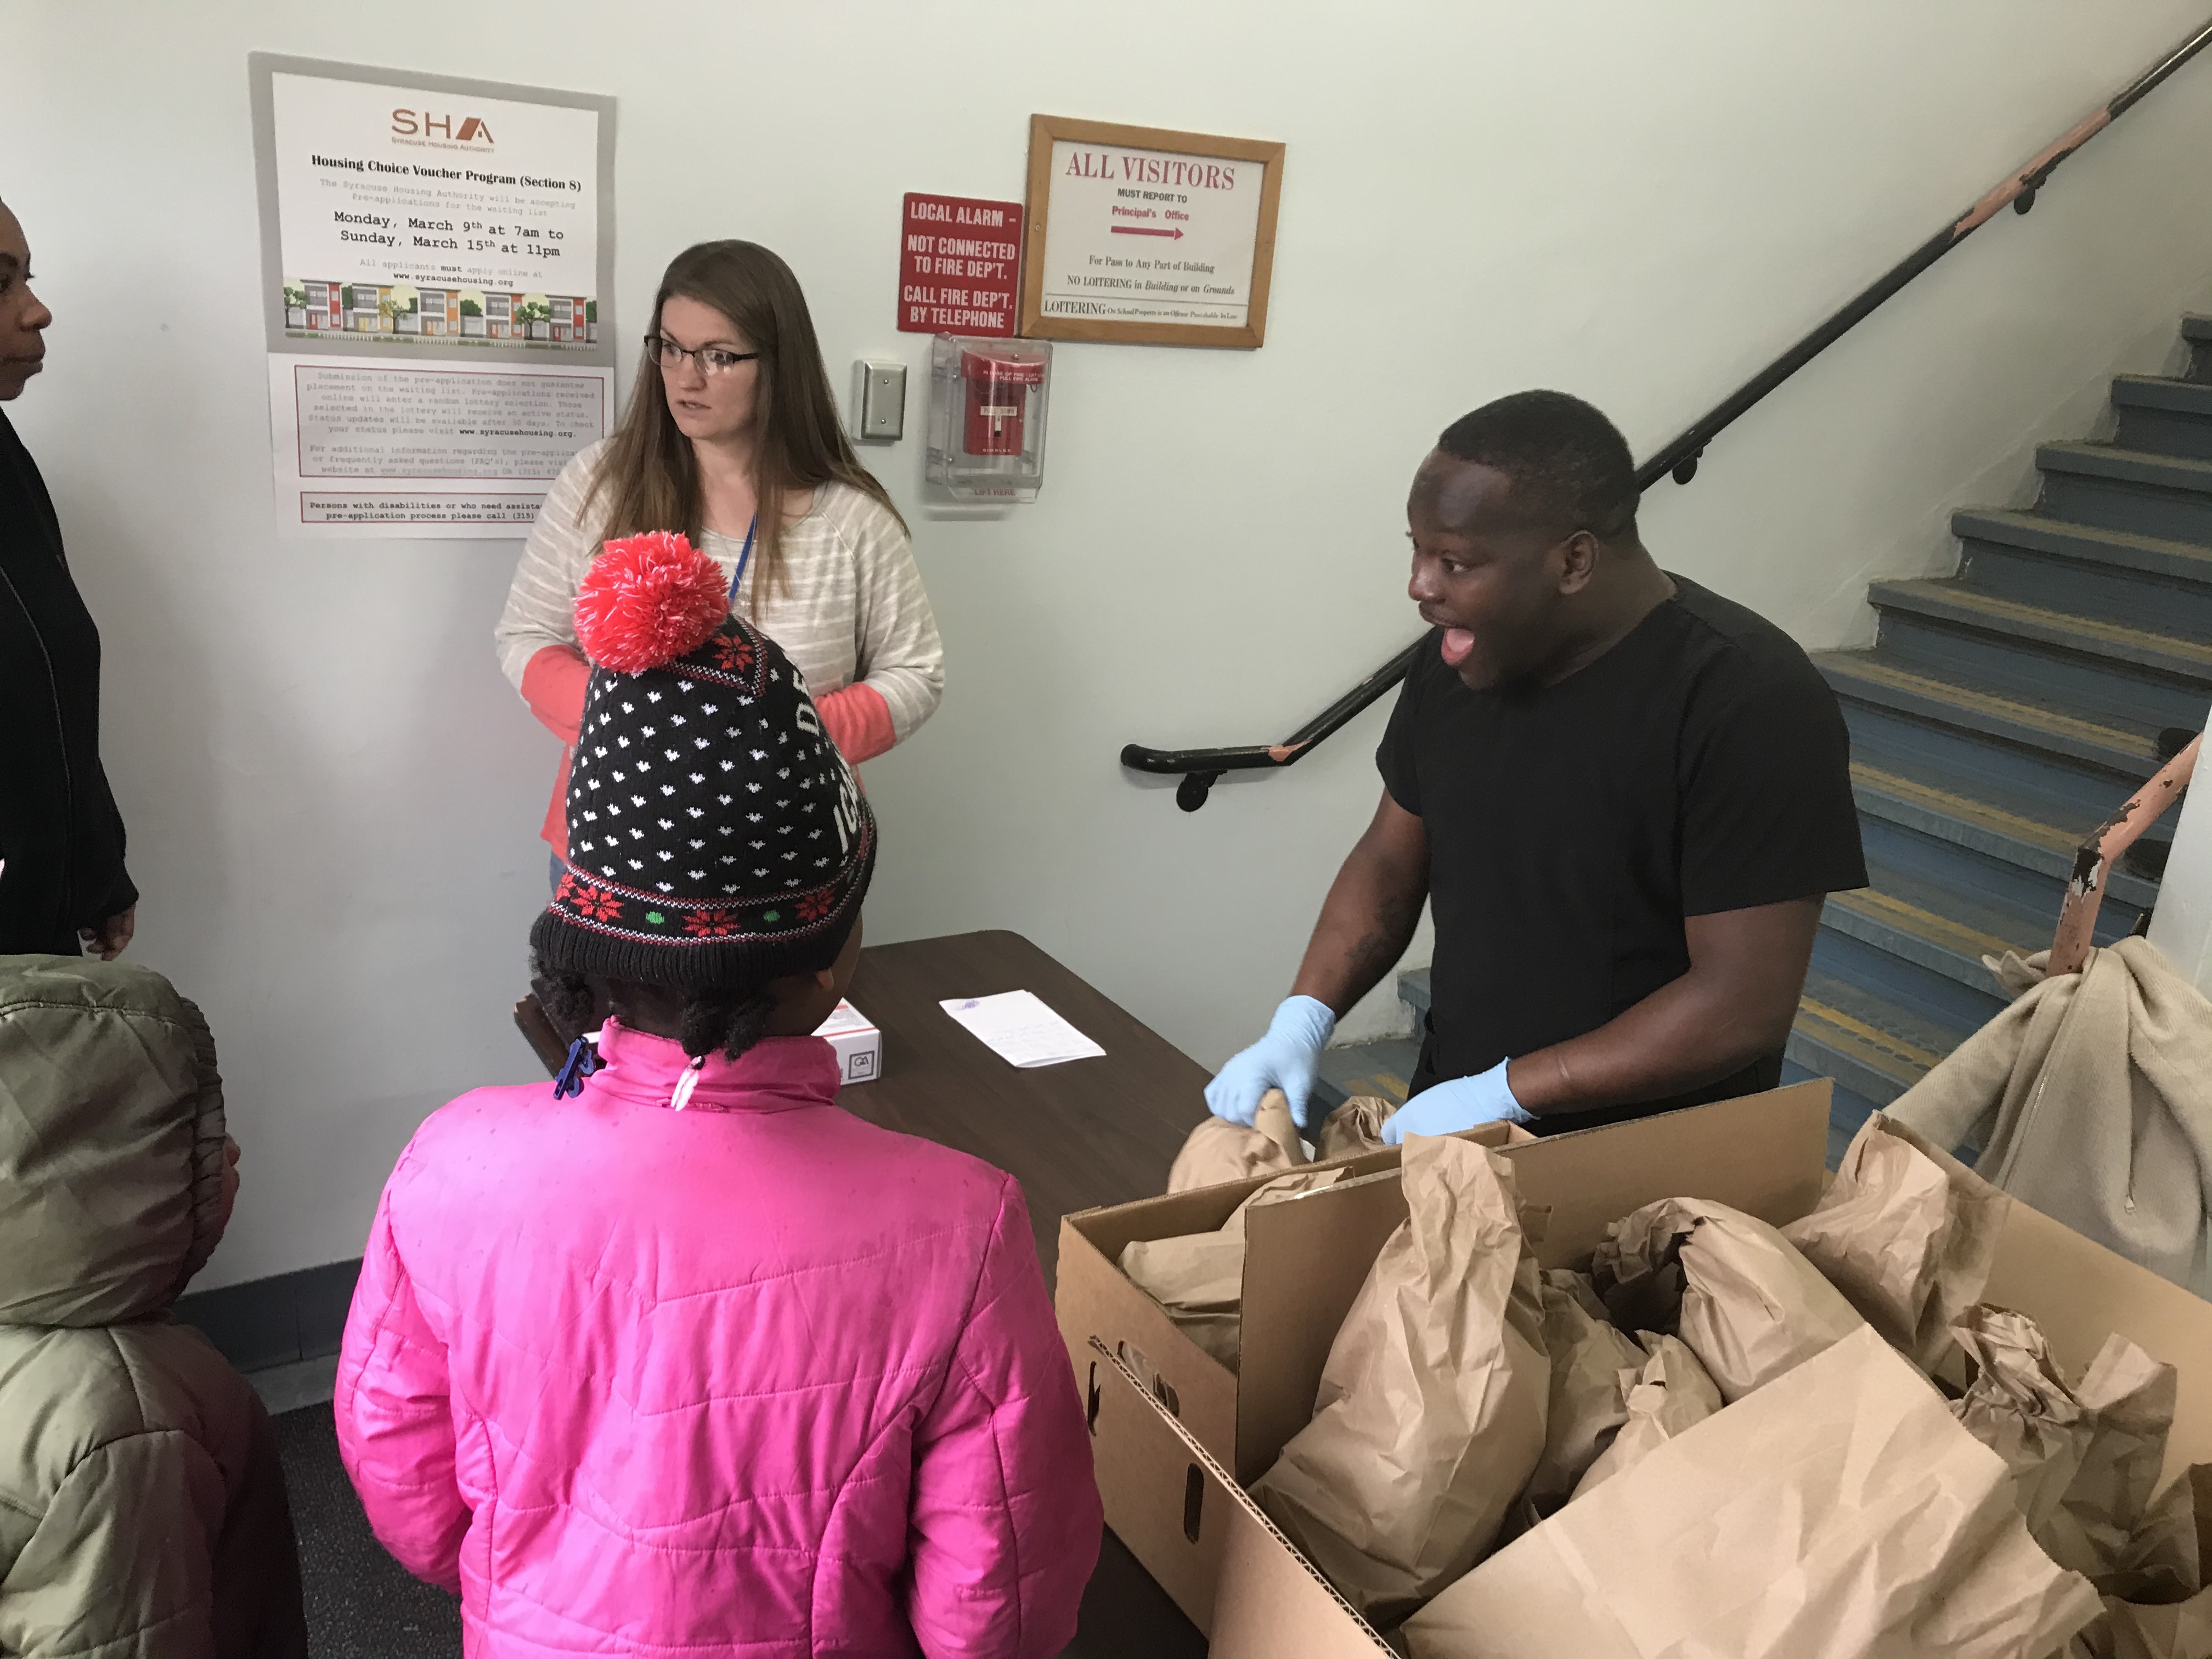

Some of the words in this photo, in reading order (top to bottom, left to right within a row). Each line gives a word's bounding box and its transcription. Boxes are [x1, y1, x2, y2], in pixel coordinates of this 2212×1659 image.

[391, 108, 494, 144] SHA
[312, 155, 364, 172] Housing
[368, 160, 409, 174] Choice
[413, 165, 461, 179] Voucher
[466, 170, 516, 185] Program
[520, 175, 565, 189] (Section
[569, 179, 581, 192] 8)
[1065, 151, 1115, 179] ALL
[1122, 156, 1234, 190] VISITORS
[320, 179, 337, 187] The
[343, 181, 387, 192] Syracuse
[393, 185, 431, 196] Housing
[437, 190, 484, 201] Authority
[489, 195, 509, 203] will
[530, 198, 575, 210] accepting
[352, 193, 439, 207] Pre-applications
[466, 203, 482, 211] the
[487, 205, 522, 215] waiting
[1118, 188, 1141, 198] MUST
[1143, 190, 1175, 202] REPORT
[1177, 194, 1187, 203] TO
[910, 201, 952, 222] LOCAL
[956, 206, 1003, 227] ALARM
[1112, 205, 1156, 219] Principal's
[1165, 210, 1189, 221] Office
[334, 211, 397, 229] Monday,
[408, 217, 453, 230] March
[463, 221, 482, 232] 9th
[488, 225, 505, 235] at
[515, 226, 539, 238] 7am
[549, 229, 564, 239] to
[341, 230, 402, 247] Sunday,
[413, 236, 458, 249] March
[467, 239, 495, 251] 15th
[501, 243, 518, 253] at
[527, 244, 560, 258] 11pm
[907, 234, 935, 253] NOT
[938, 237, 1015, 259] CONNECTED
[382, 261, 436, 271] applicants
[467, 267, 493, 275] apply
[498, 268, 528, 277] online
[915, 256, 932, 273] TO
[935, 257, 963, 275] FIRE
[967, 261, 1007, 279] DEP'T.
[1089, 255, 1103, 266] For
[1105, 256, 1122, 266] Pass
[1125, 258, 1133, 267] to
[1135, 259, 1152, 270] Any
[1154, 259, 1170, 269] Part
[1173, 261, 1182, 270] of
[1183, 262, 1215, 274] Building
[393, 273, 514, 287] www.syracusehousing.org
[1067, 275, 1080, 286] NO
[1083, 275, 1132, 289] LOITERING
[1135, 279, 1142, 289] in
[1145, 280, 1178, 292] Building
[1203, 284, 1235, 295] Grounds
[904, 285, 936, 303] CALL
[940, 288, 968, 306] FIRE
[973, 291, 1012, 309] DEP'T.
[1044, 300, 1106, 315] LOITERING
[910, 306, 927, 323] BY
[931, 307, 1005, 328] TELEPHONE
[522, 450, 577, 459] pre-applica
[326, 512, 405, 521] pre-application
[451, 512, 482, 521] please
